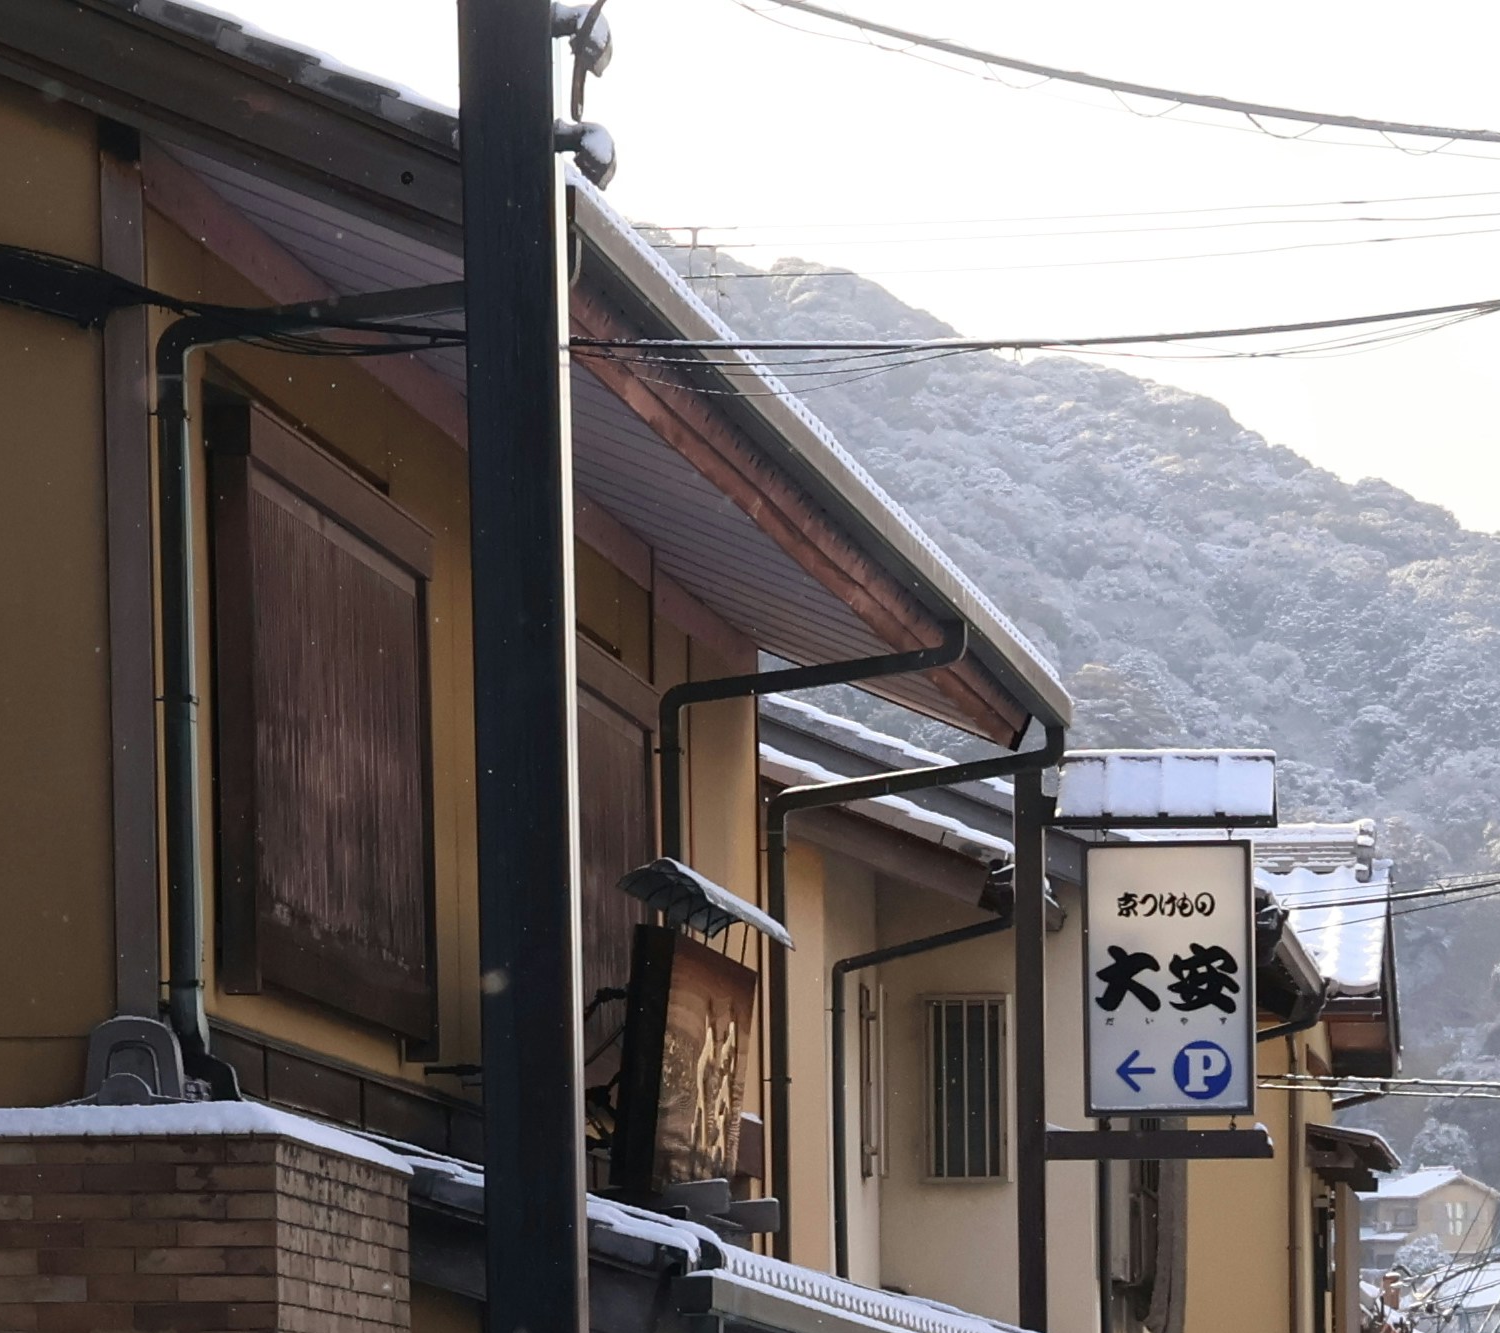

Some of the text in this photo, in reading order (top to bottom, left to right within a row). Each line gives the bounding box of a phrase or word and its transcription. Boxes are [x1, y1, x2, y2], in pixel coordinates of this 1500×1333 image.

[1117, 892, 1215, 917] 京つけもの
[1095, 943, 1240, 1014] 大安
[1105, 1016, 1228, 1026] だいやす
[1184, 1048, 1227, 1092] P
